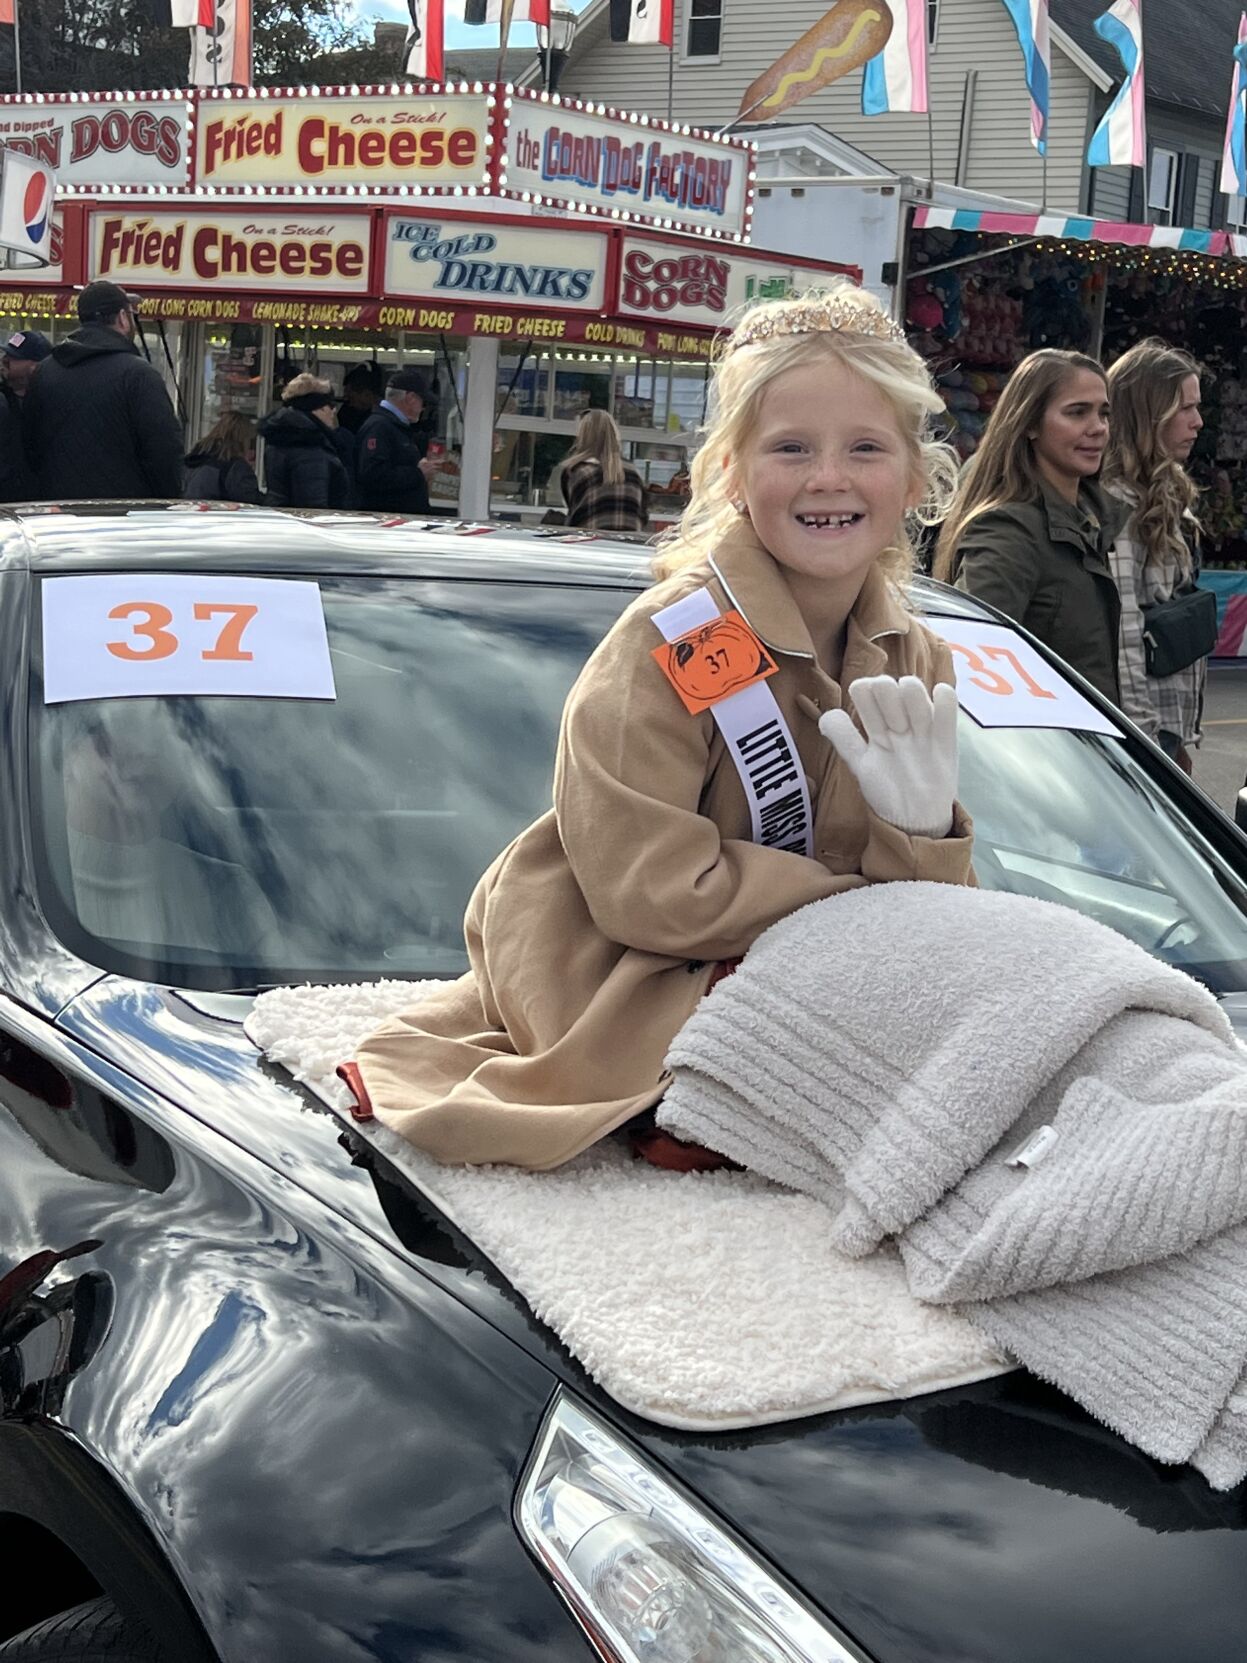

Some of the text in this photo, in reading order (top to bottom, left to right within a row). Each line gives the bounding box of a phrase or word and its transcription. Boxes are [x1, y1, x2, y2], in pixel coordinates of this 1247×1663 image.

[13, 117, 54, 133] Dipped
[350, 111, 447, 125] On a Stick!
[70, 109, 182, 168] DOGS
[204, 110, 477, 175] Fried Cheese
[516, 126, 732, 216] the CORN DOG FACTORY
[242, 224, 335, 236] On a Stick!
[393, 221, 442, 242] ICE
[99, 219, 185, 275] Fried
[192, 226, 364, 280] Cheese
[410, 233, 497, 262] COLD
[433, 259, 595, 301] DRINKS
[625, 250, 731, 297] CORN
[160, 299, 186, 316] LONG
[187, 300, 213, 317] CORN
[215, 300, 240, 318] DOGS
[622, 274, 726, 312] DOGS
[252, 302, 306, 321] LEMONADE
[378, 306, 455, 330] CORN DOGS
[473, 313, 567, 338] FRIED CHEESE
[585, 322, 614, 342] COLD
[105, 601, 258, 661] 37
[704, 648, 731, 675] 37
[949, 642, 1058, 700] 37
[736, 719, 798, 800] LITTLE
[759, 787, 807, 845] MISS
